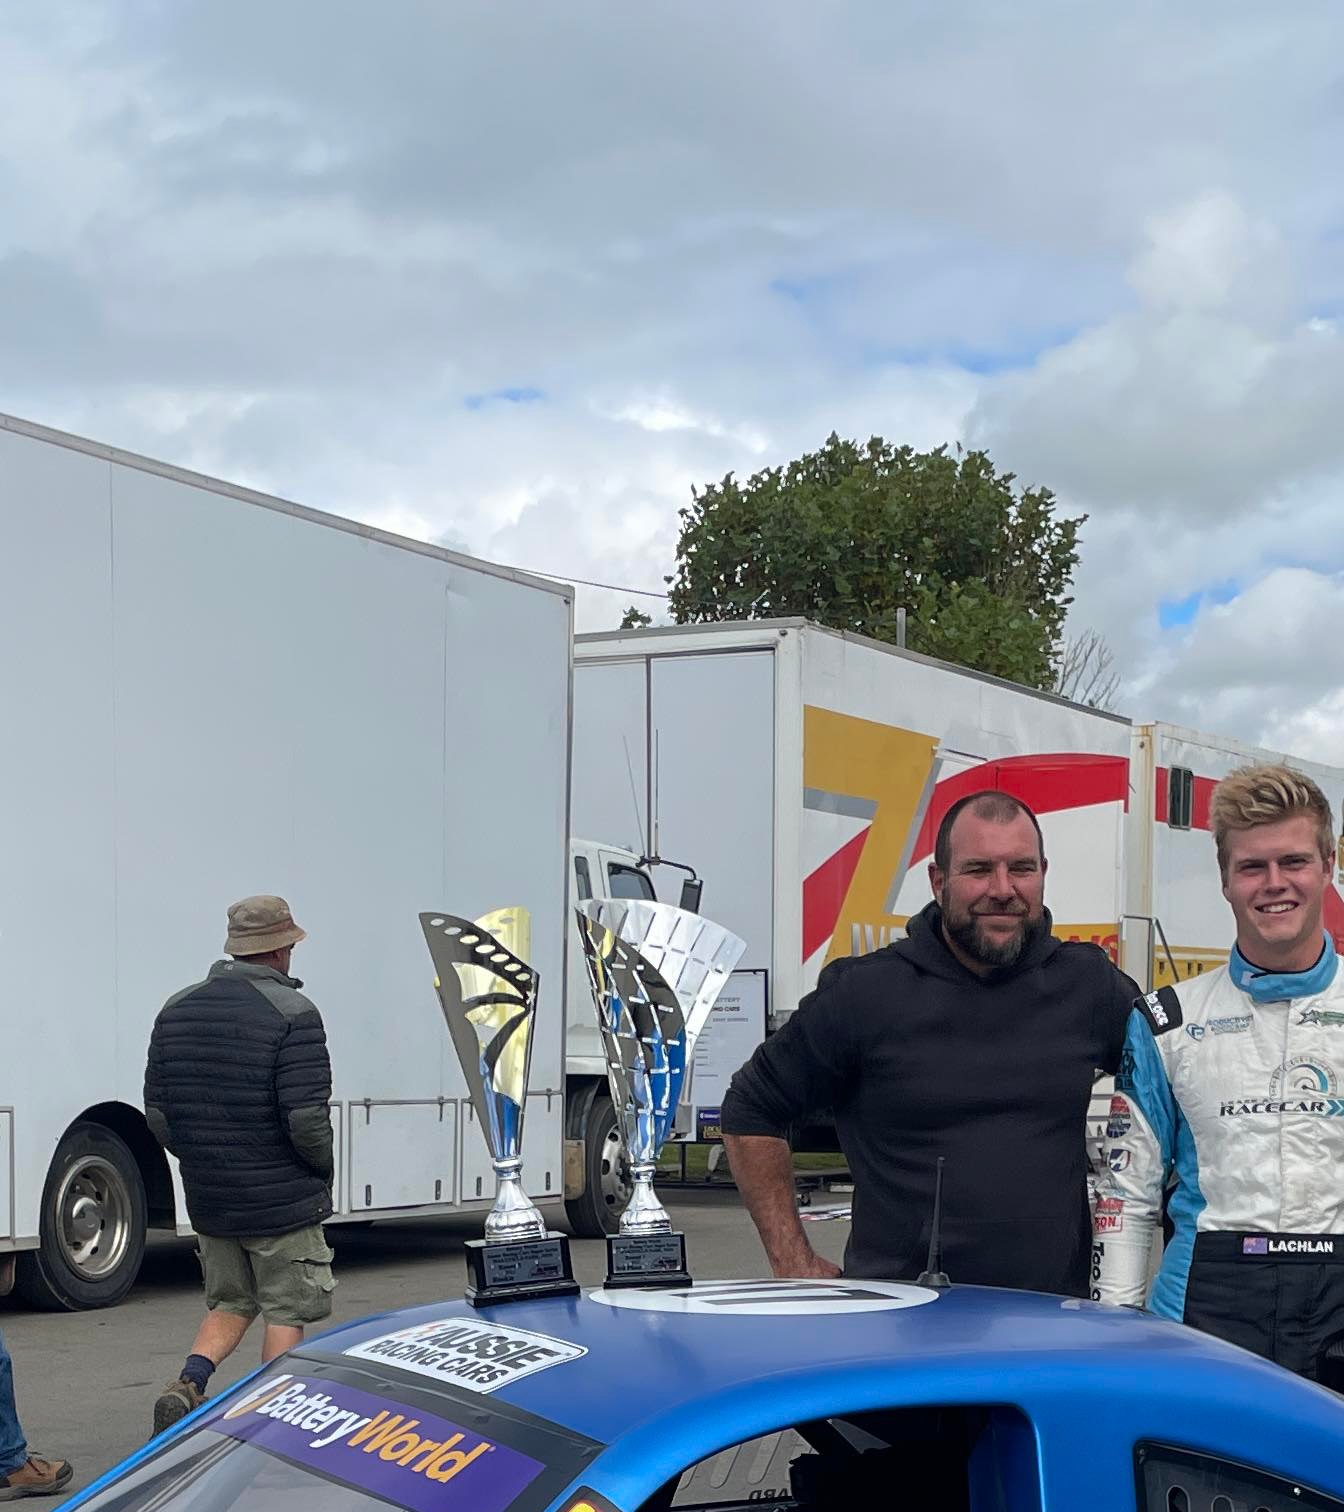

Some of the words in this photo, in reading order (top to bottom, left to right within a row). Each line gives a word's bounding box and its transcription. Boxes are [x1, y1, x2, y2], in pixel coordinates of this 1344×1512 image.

[1219, 1101, 1326, 1117] RACECAR
[1268, 1239, 1334, 1254] LACHLAN
[363, 1339, 444, 1368] RACING
[436, 1356, 510, 1385] CARS
[416, 1326, 562, 1371] AUSSIE
[256, 1382, 373, 1449] Battery
[347, 1409, 490, 1484] World
